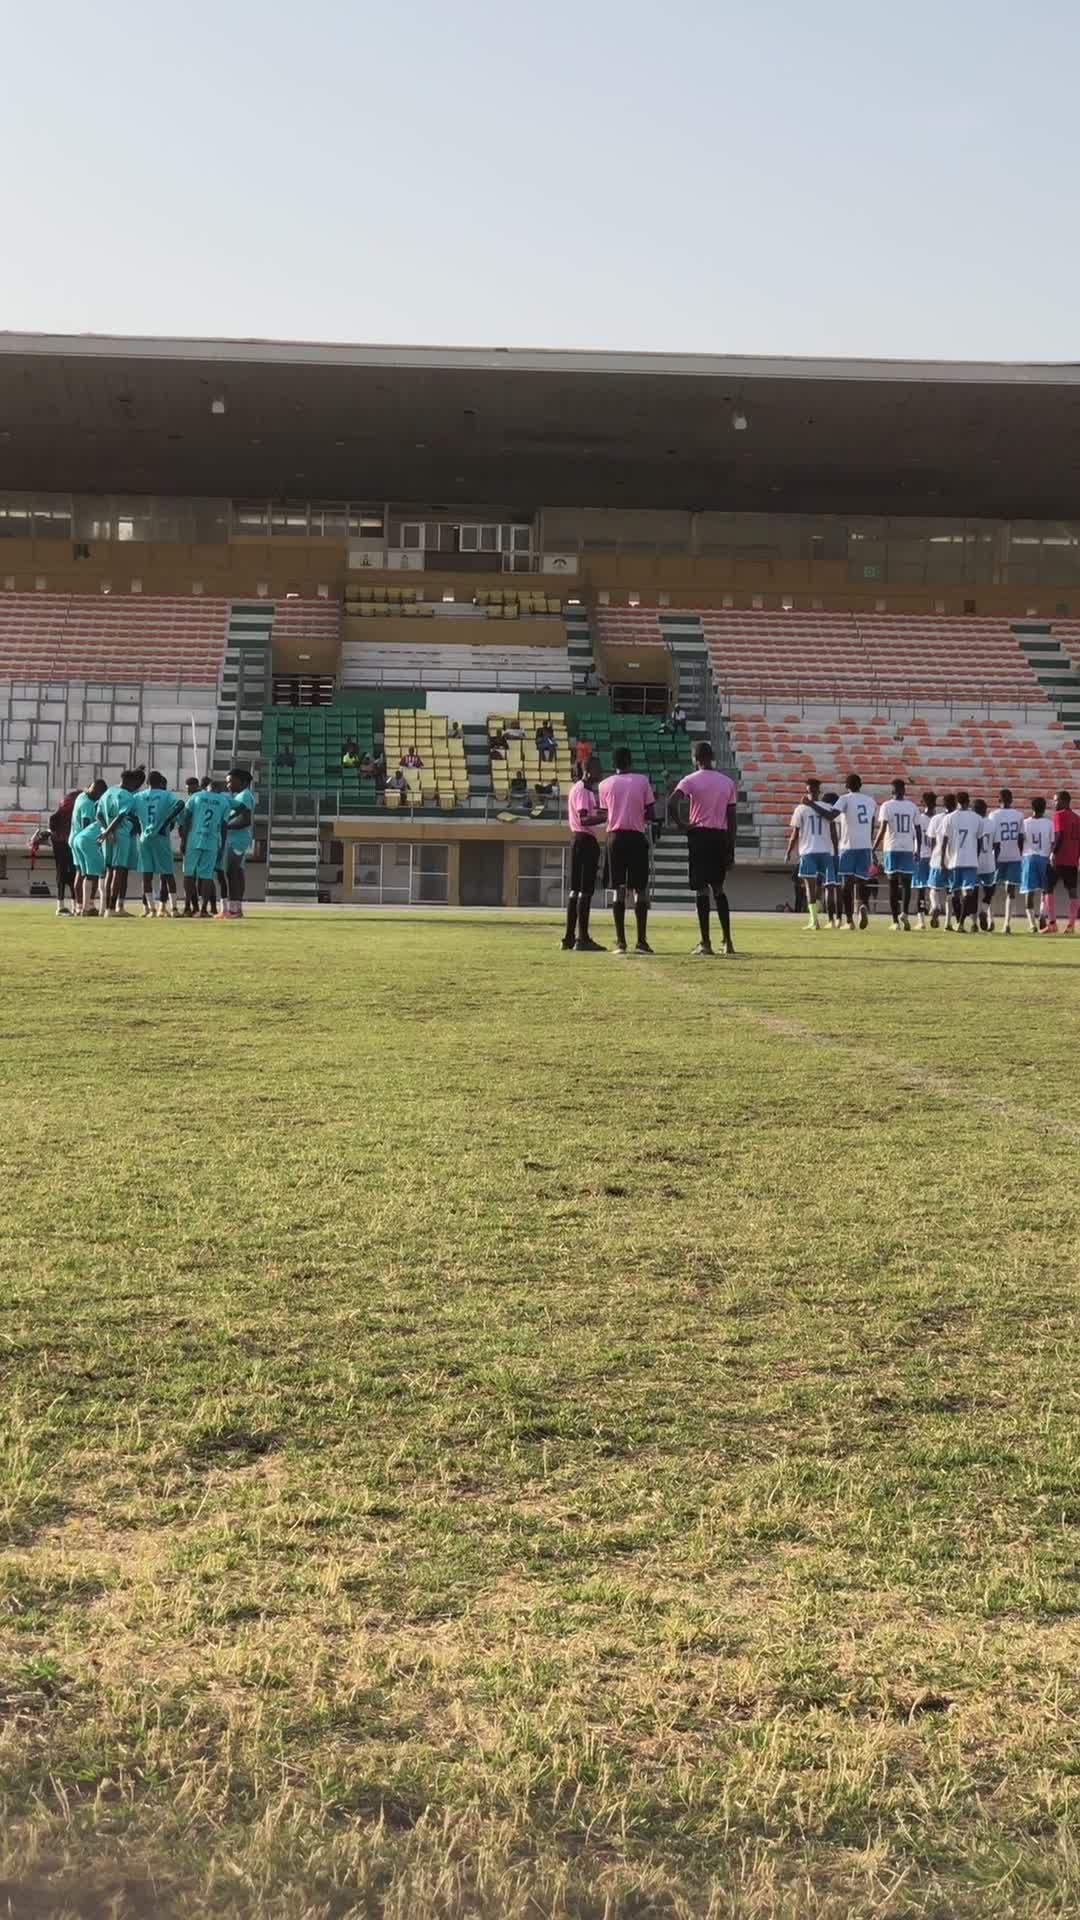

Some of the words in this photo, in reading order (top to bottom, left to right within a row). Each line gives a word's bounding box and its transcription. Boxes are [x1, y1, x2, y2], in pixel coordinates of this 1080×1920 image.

[203, 809, 214, 828] 2
[857, 804, 869, 825] 2
[894, 813, 911, 833] 10
[808, 815, 822, 835] 11
[1000, 822, 1018, 841] 22
[958, 829, 969, 849] 7
[1032, 832, 1042, 850] 4
